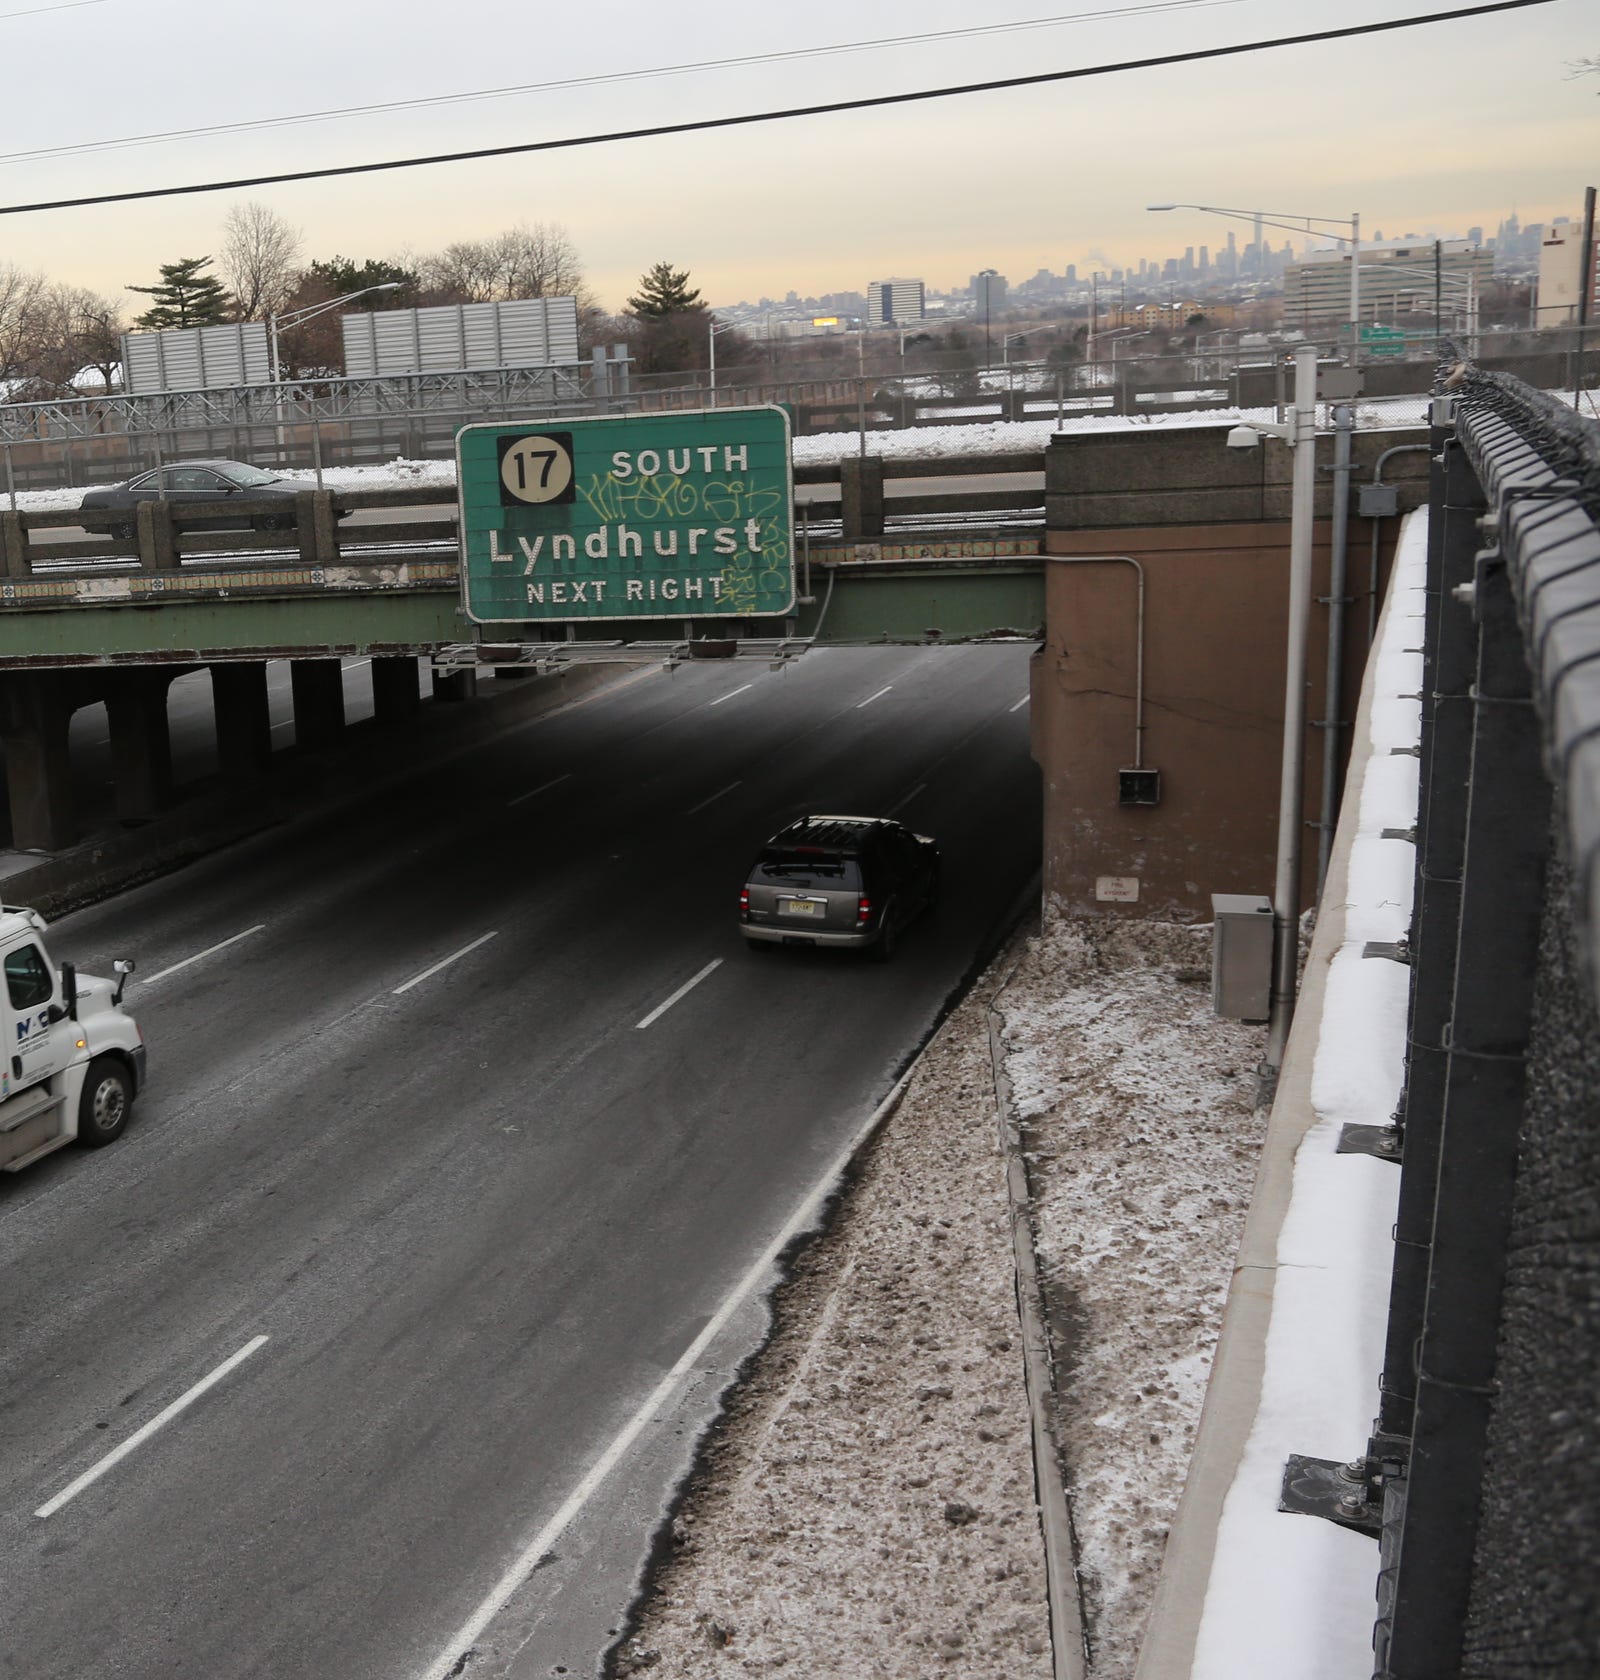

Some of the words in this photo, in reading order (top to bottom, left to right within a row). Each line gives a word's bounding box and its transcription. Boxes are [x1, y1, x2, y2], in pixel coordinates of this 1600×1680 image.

[513, 450, 558, 490] 17
[612, 444, 748, 478] SOUTH
[489, 518, 763, 575] Lyndhurst
[527, 581, 607, 603] NEXT
[626, 576, 724, 601] RIGHT
[16, 1010, 49, 1040] NAC
